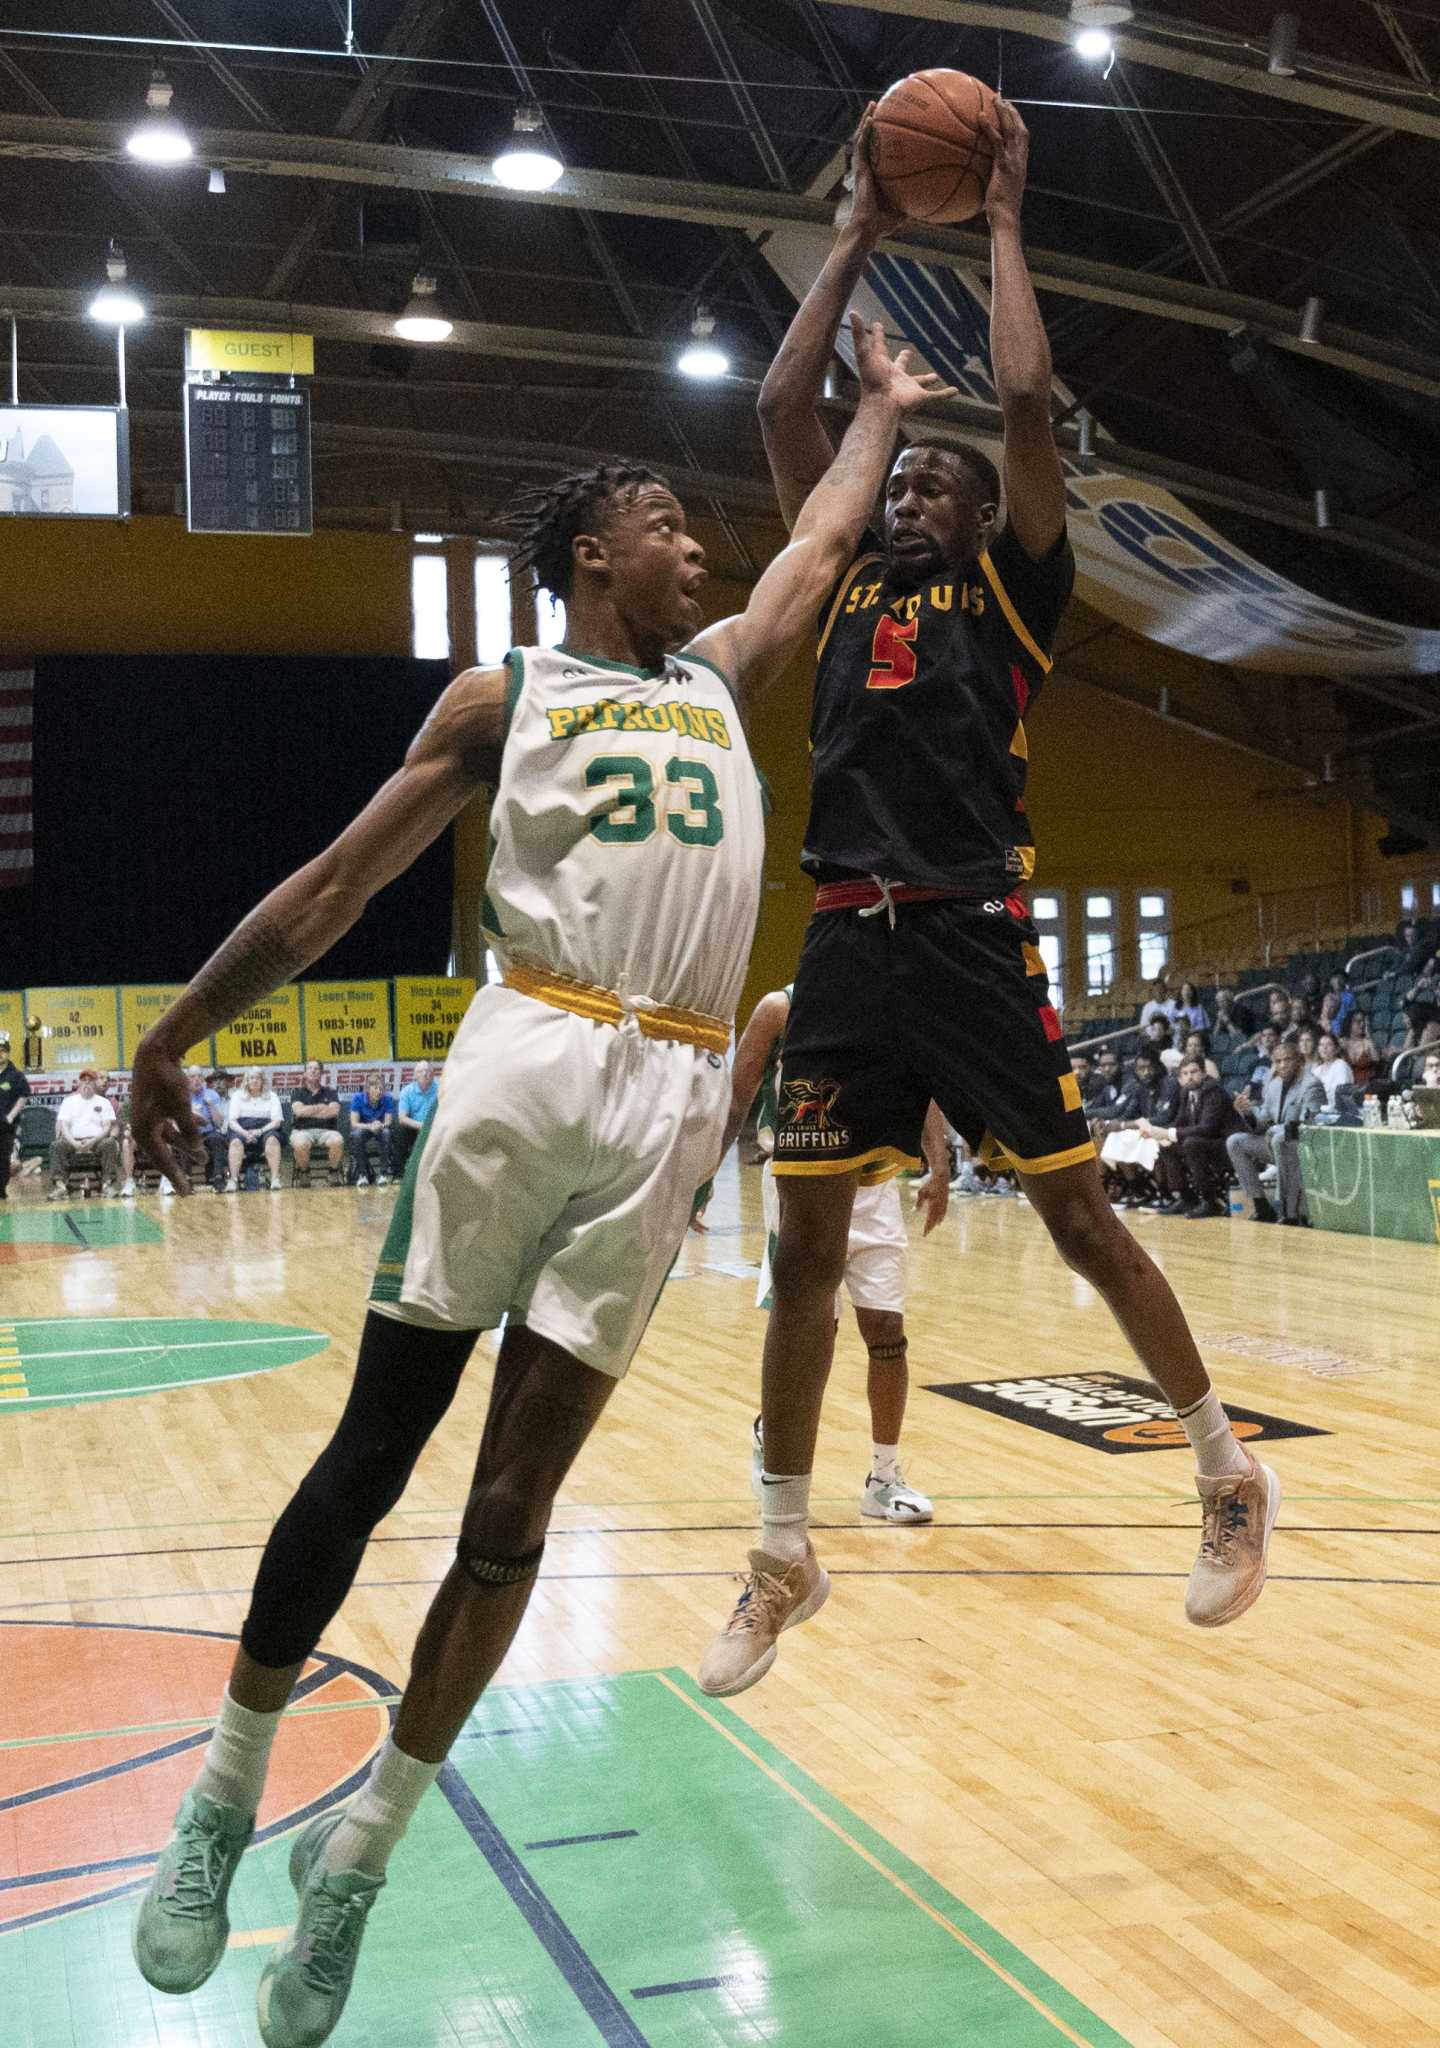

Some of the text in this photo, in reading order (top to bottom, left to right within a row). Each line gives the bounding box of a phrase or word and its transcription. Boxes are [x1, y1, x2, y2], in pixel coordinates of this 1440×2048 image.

[225, 343, 283, 357] GUEST
[195, 389, 302, 405] PLAYER FOULS POINTS
[866, 614, 918, 688] 5
[582, 753, 724, 850] 33
[69, 1011, 80, 1023] 42
[343, 1005, 349, 1015] 1
[240, 1039, 277, 1057] NBA
[330, 1036, 366, 1056] NBA
[422, 1031, 455, 1049] NBA
[272, 1071, 331, 1088] ESN
[779, 1129, 849, 1148] GRIFFINS
[969, 1379, 1152, 1427] UPSIDE
